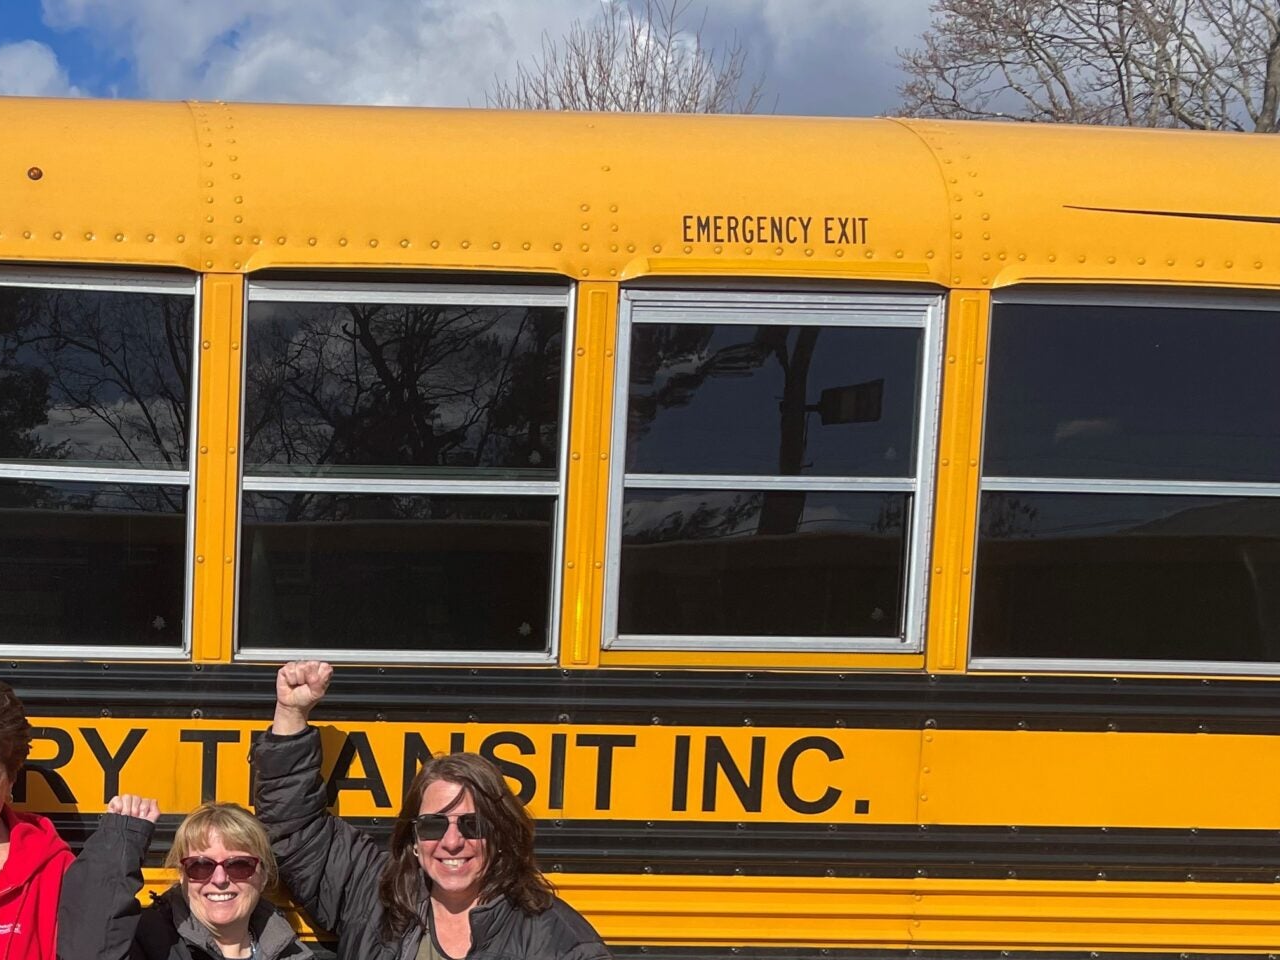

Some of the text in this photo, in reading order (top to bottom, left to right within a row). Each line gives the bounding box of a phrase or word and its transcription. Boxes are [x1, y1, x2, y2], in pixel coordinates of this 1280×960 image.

[682, 215, 869, 244] EMERGENCY EXIT
[180, 729, 637, 811] TASIT
[672, 735, 870, 815] INC.
